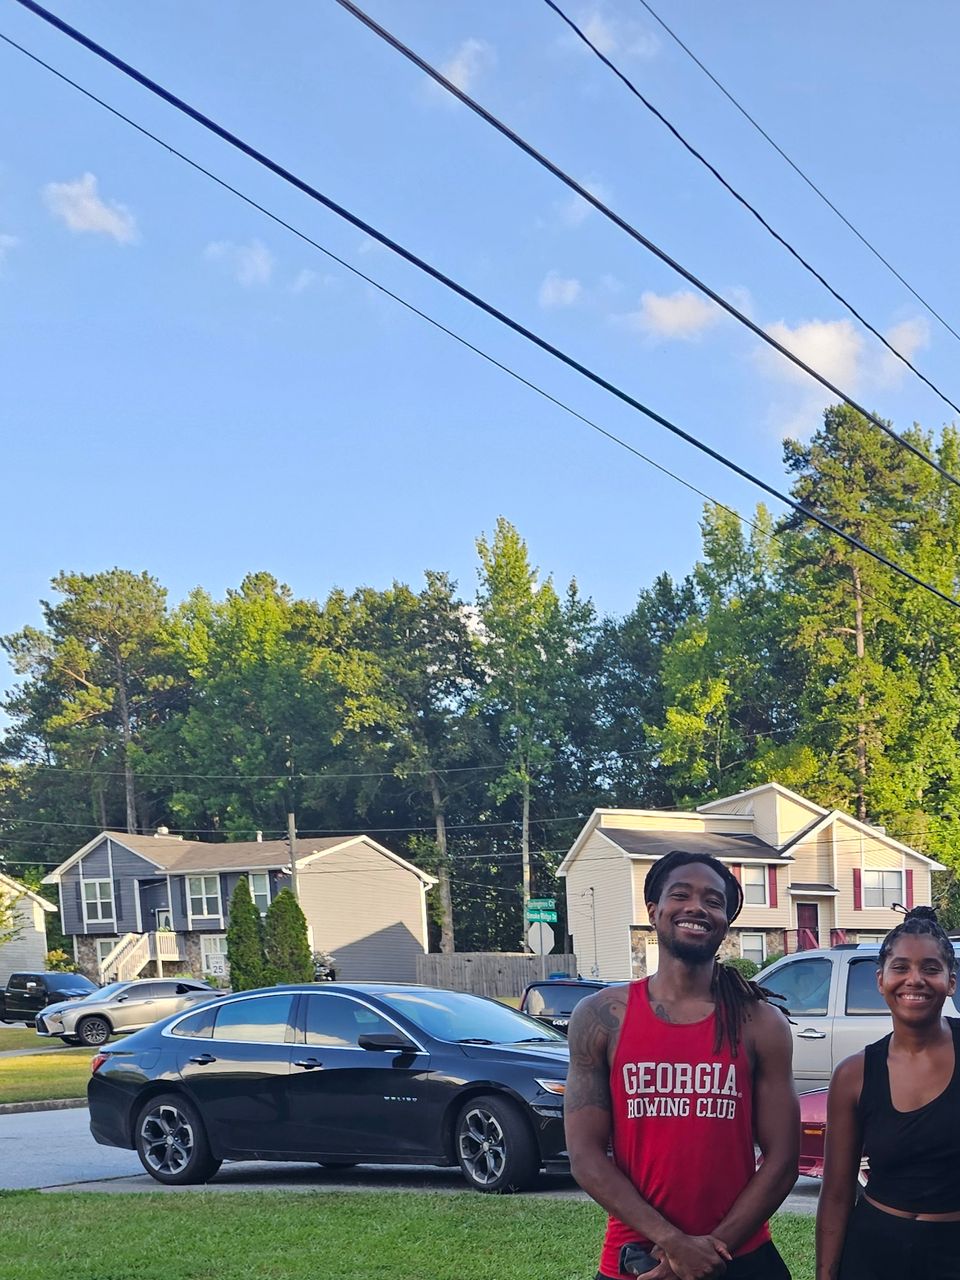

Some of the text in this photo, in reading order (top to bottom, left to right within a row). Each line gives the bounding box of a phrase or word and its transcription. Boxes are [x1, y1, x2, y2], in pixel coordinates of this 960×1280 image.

[213, 965, 224, 974] 25
[622, 1062, 738, 1097] GEORGIA
[627, 1097, 736, 1120] ROWING CLUB
